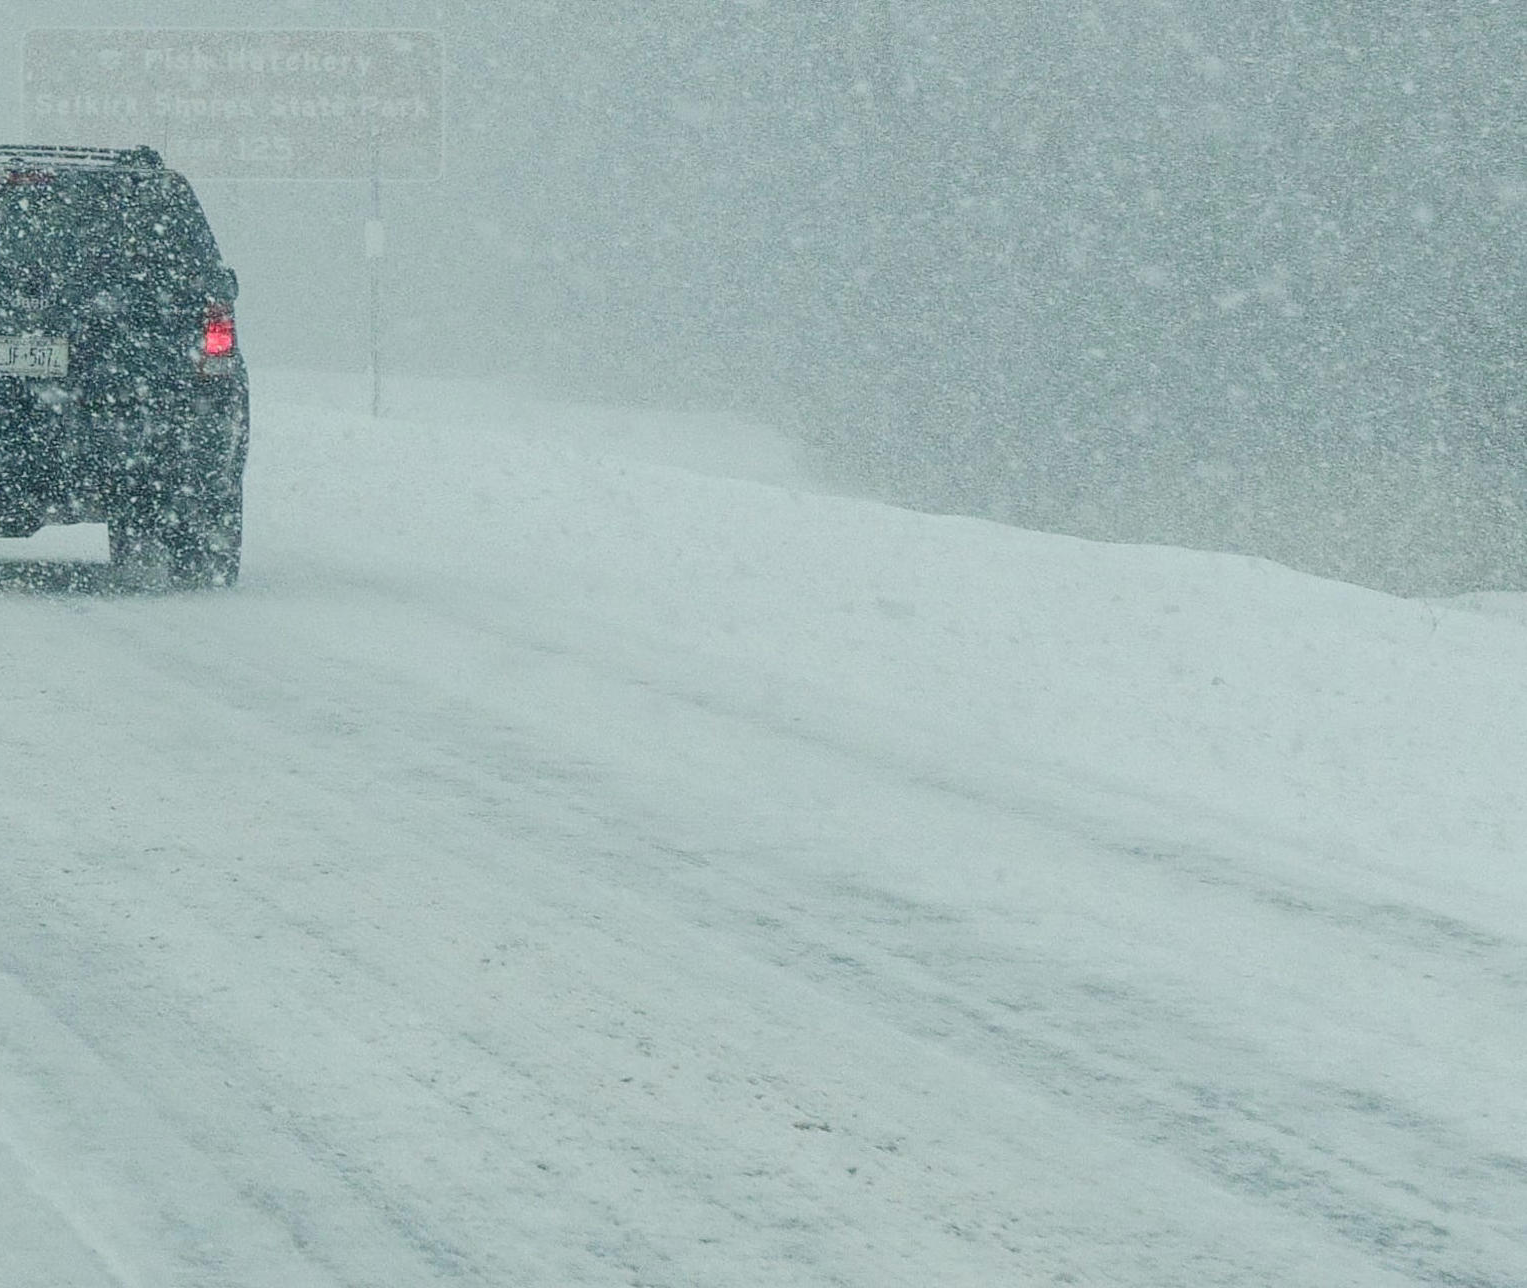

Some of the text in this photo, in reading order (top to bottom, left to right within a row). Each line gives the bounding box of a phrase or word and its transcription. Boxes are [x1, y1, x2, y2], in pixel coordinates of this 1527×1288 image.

[143, 46, 373, 76] Fish Hatchery
[34, 93, 430, 118] Selkirk Shores State Park
